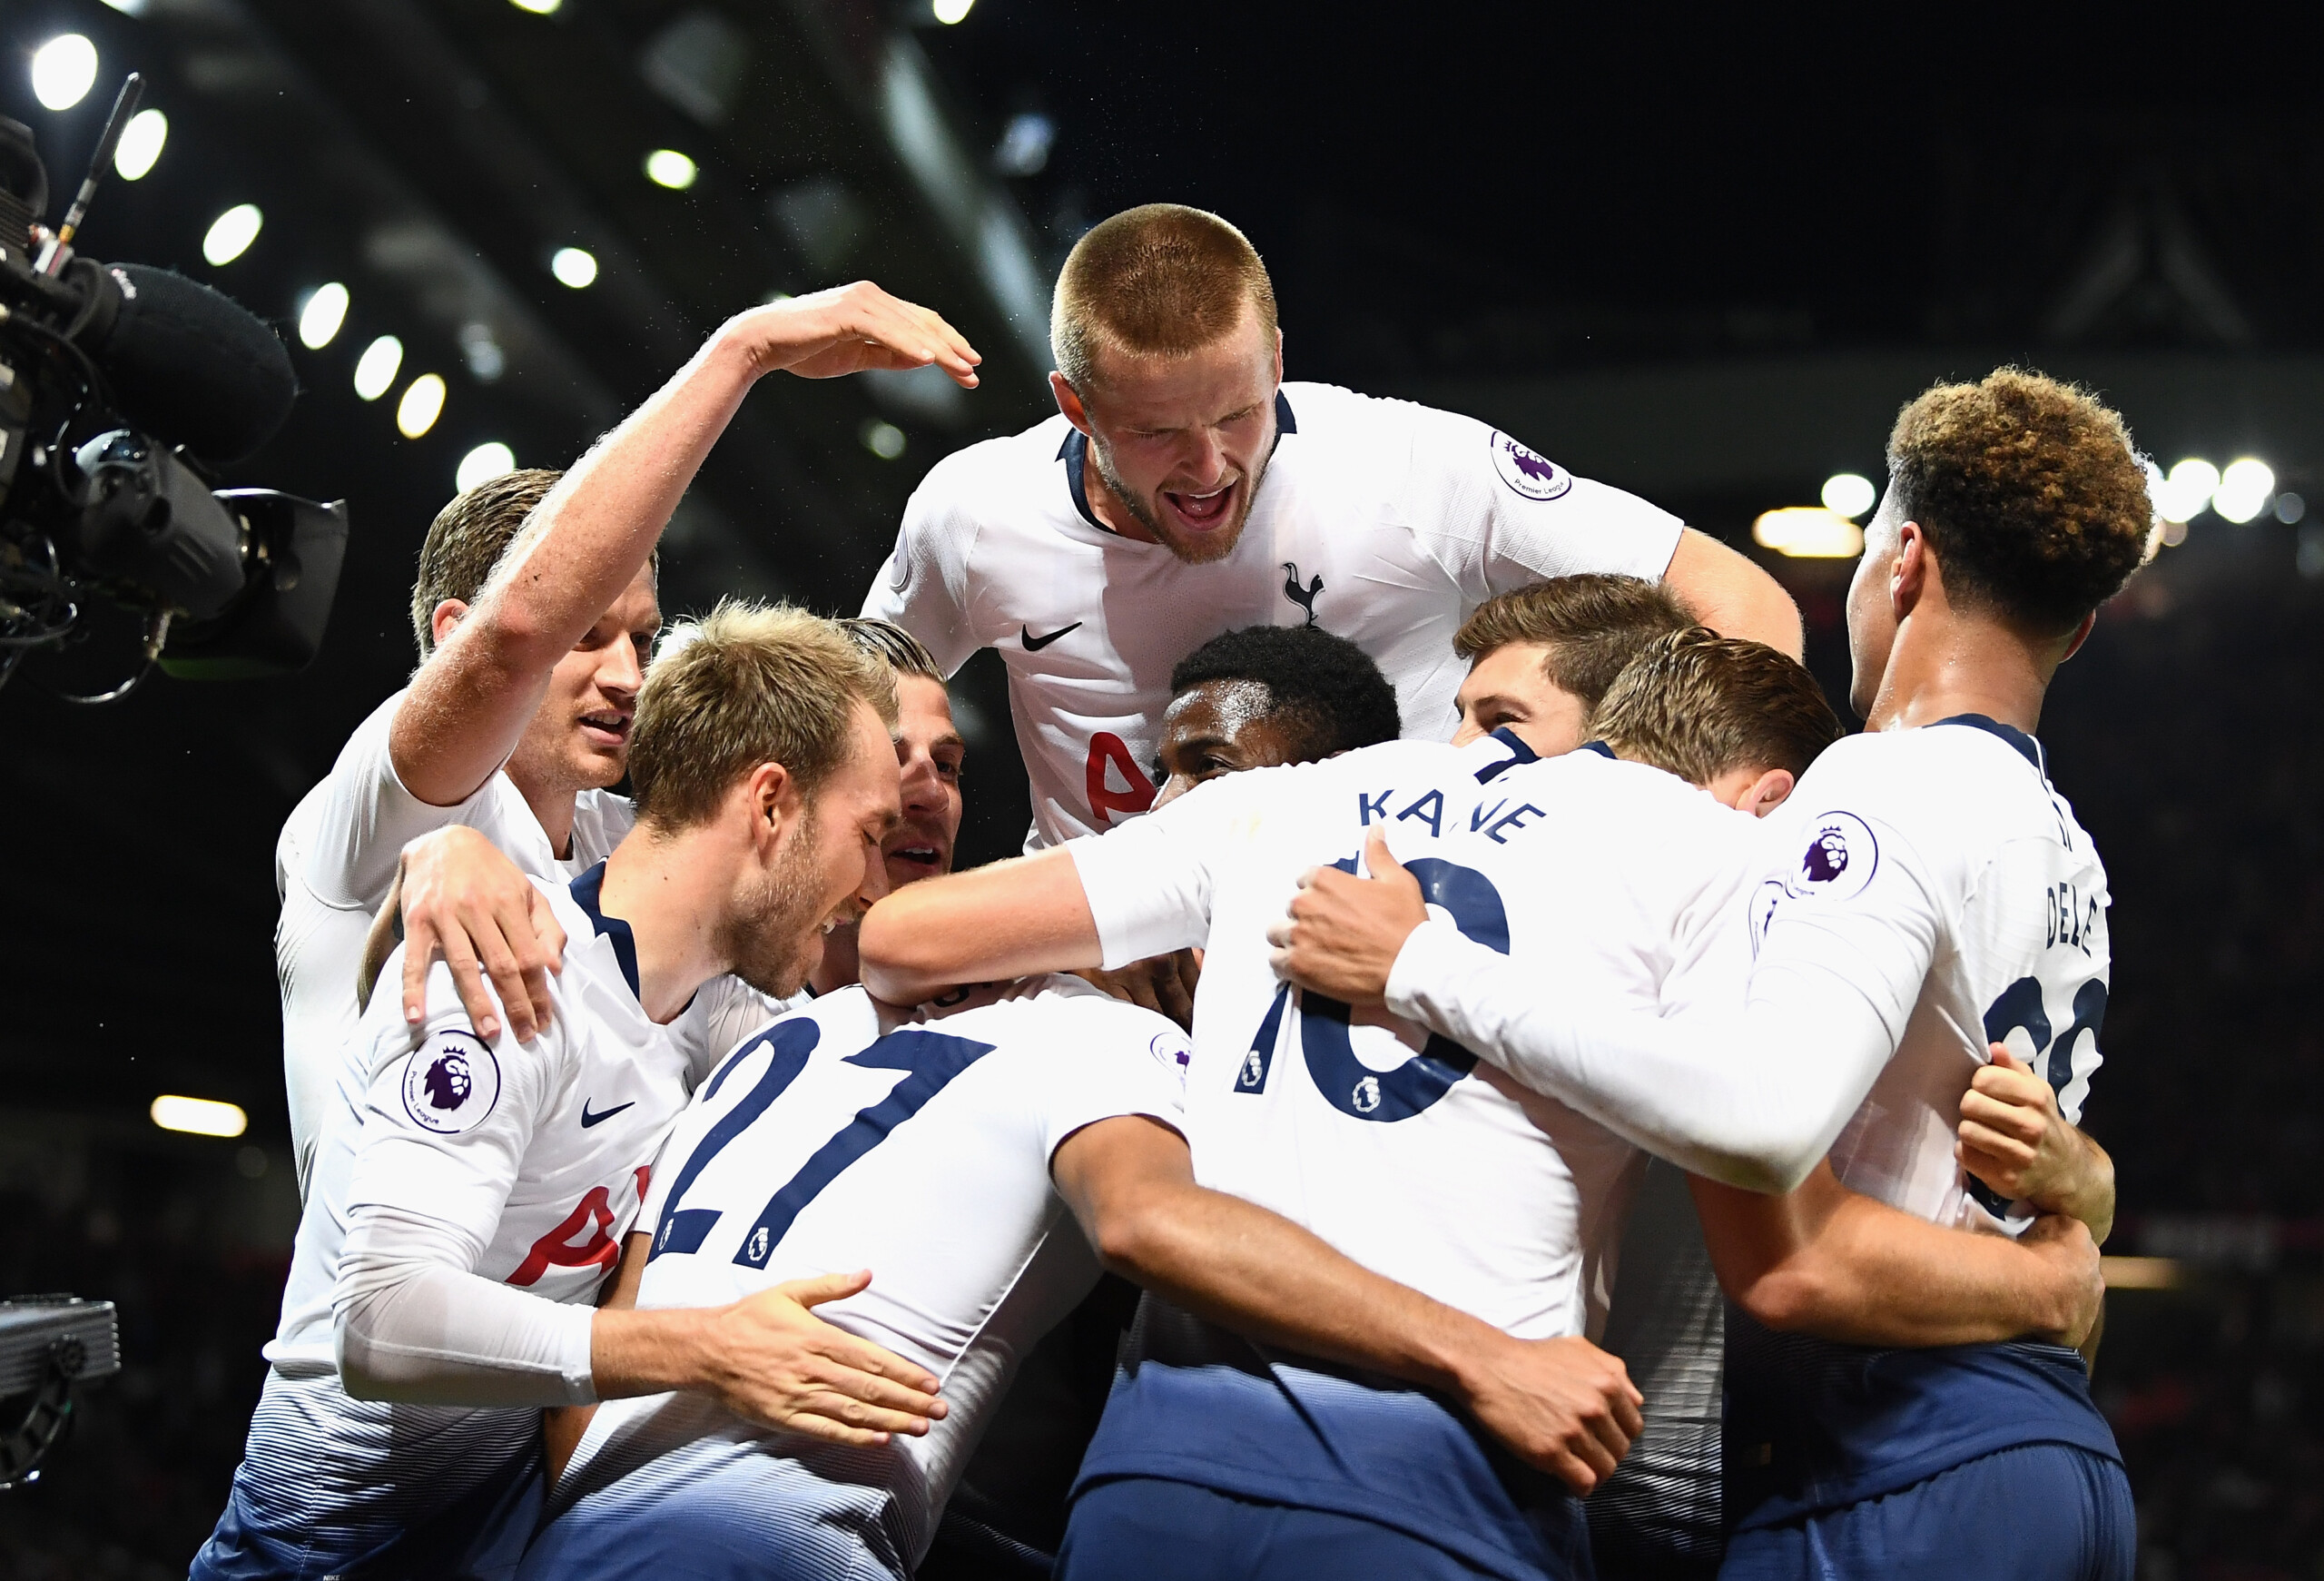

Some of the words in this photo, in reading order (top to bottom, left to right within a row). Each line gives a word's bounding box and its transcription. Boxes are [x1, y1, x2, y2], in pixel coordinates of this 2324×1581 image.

[1513, 478, 1541, 495] Premier
[1358, 788, 1547, 845] KANE
[2045, 881, 2098, 959] DELE
[409, 1070, 418, 1102] Premier
[413, 1103, 439, 1125] League
[646, 1016, 998, 1271] 27
